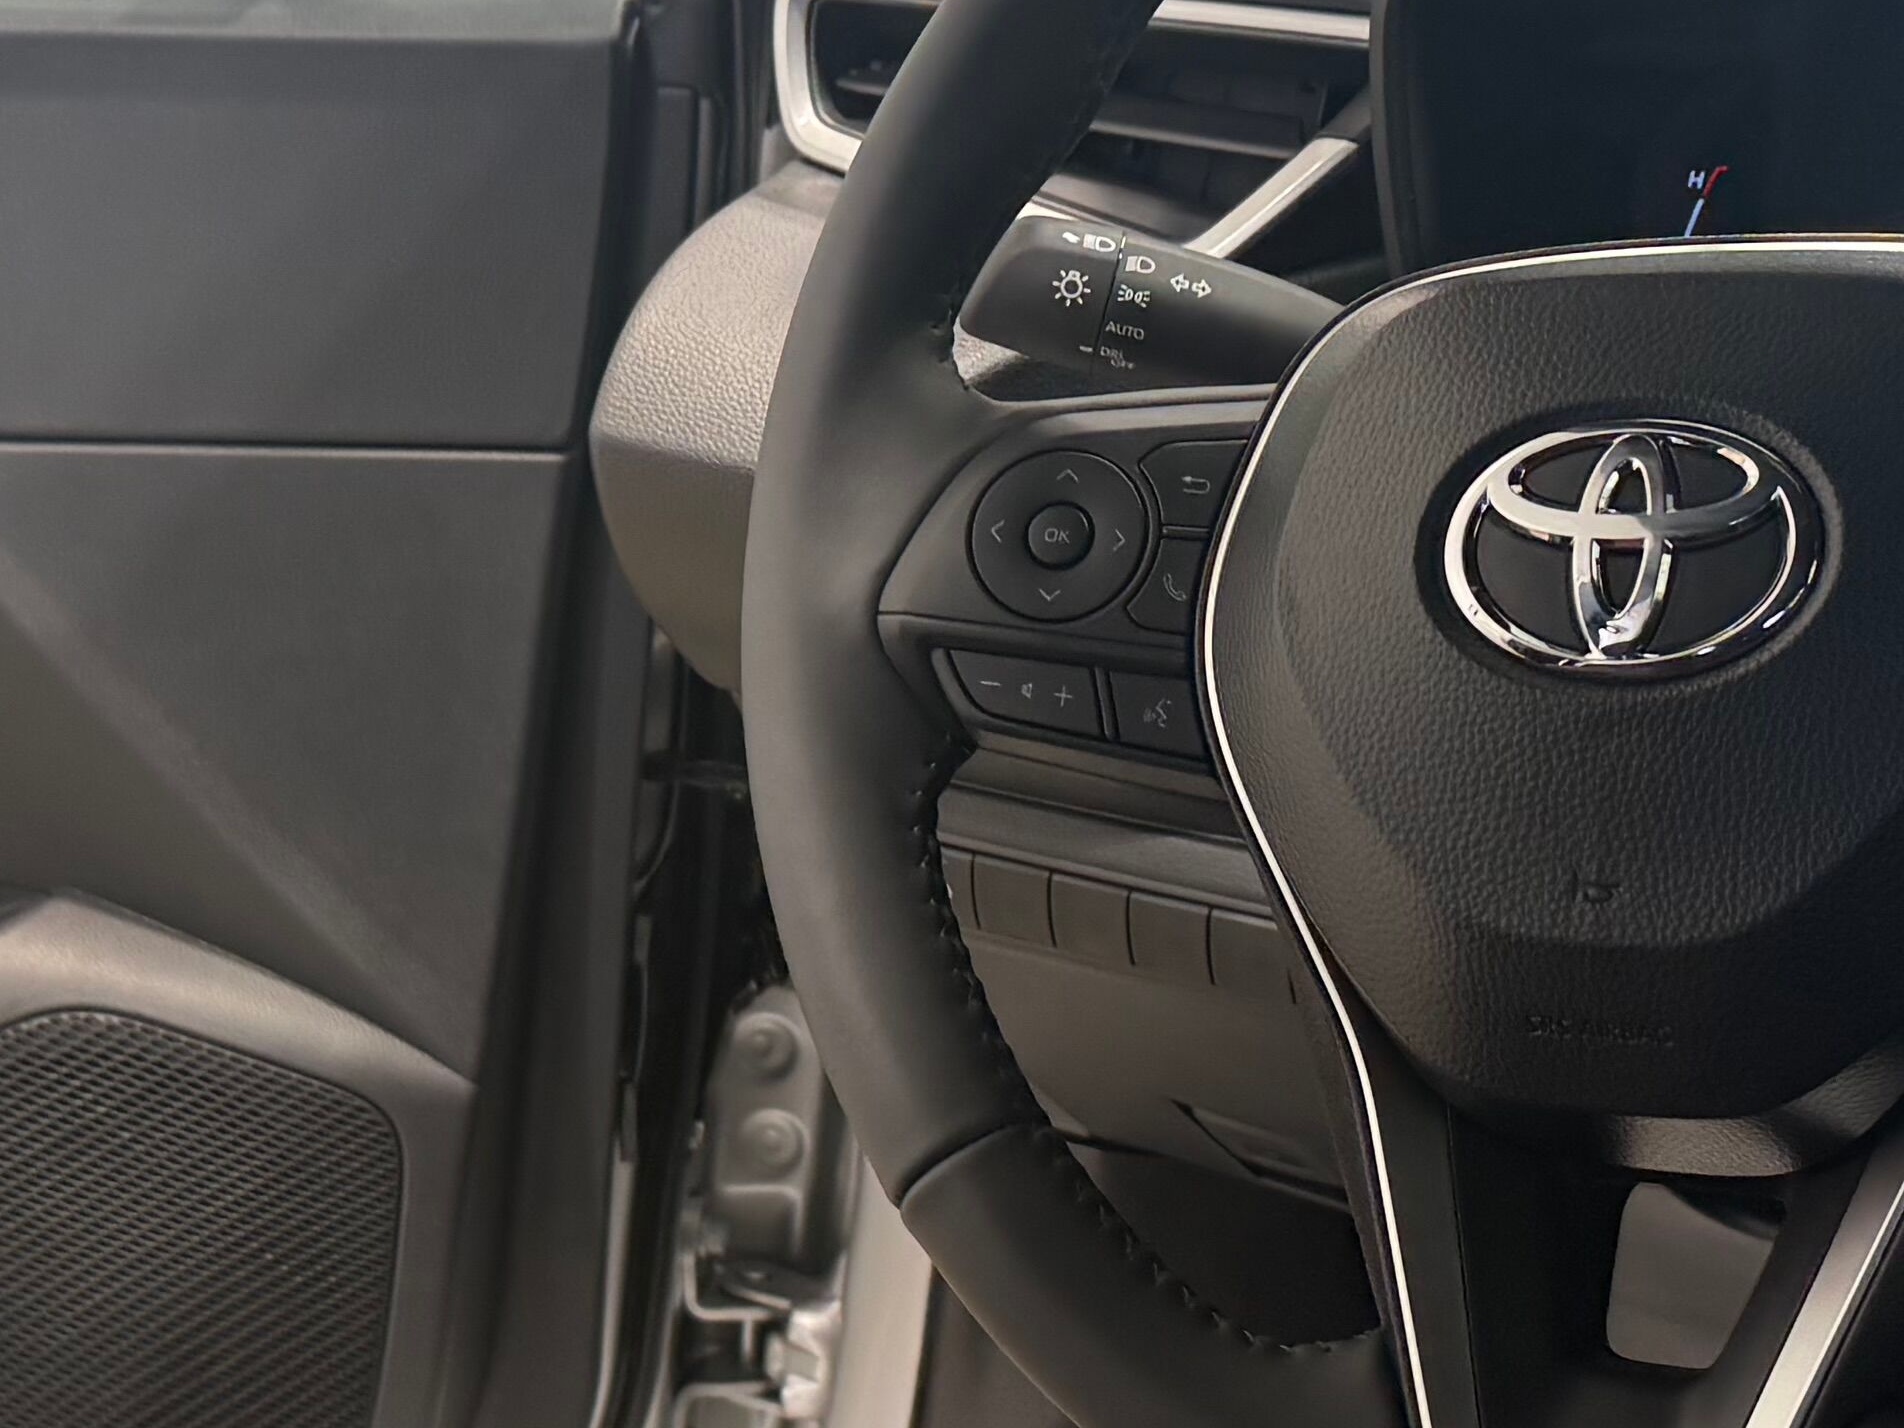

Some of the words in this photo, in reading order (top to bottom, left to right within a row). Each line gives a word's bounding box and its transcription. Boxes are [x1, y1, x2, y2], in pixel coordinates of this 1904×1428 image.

[1687, 170, 1705, 189] H
[1105, 320, 1145, 341] AUTO
[1044, 528, 1071, 544] OK
